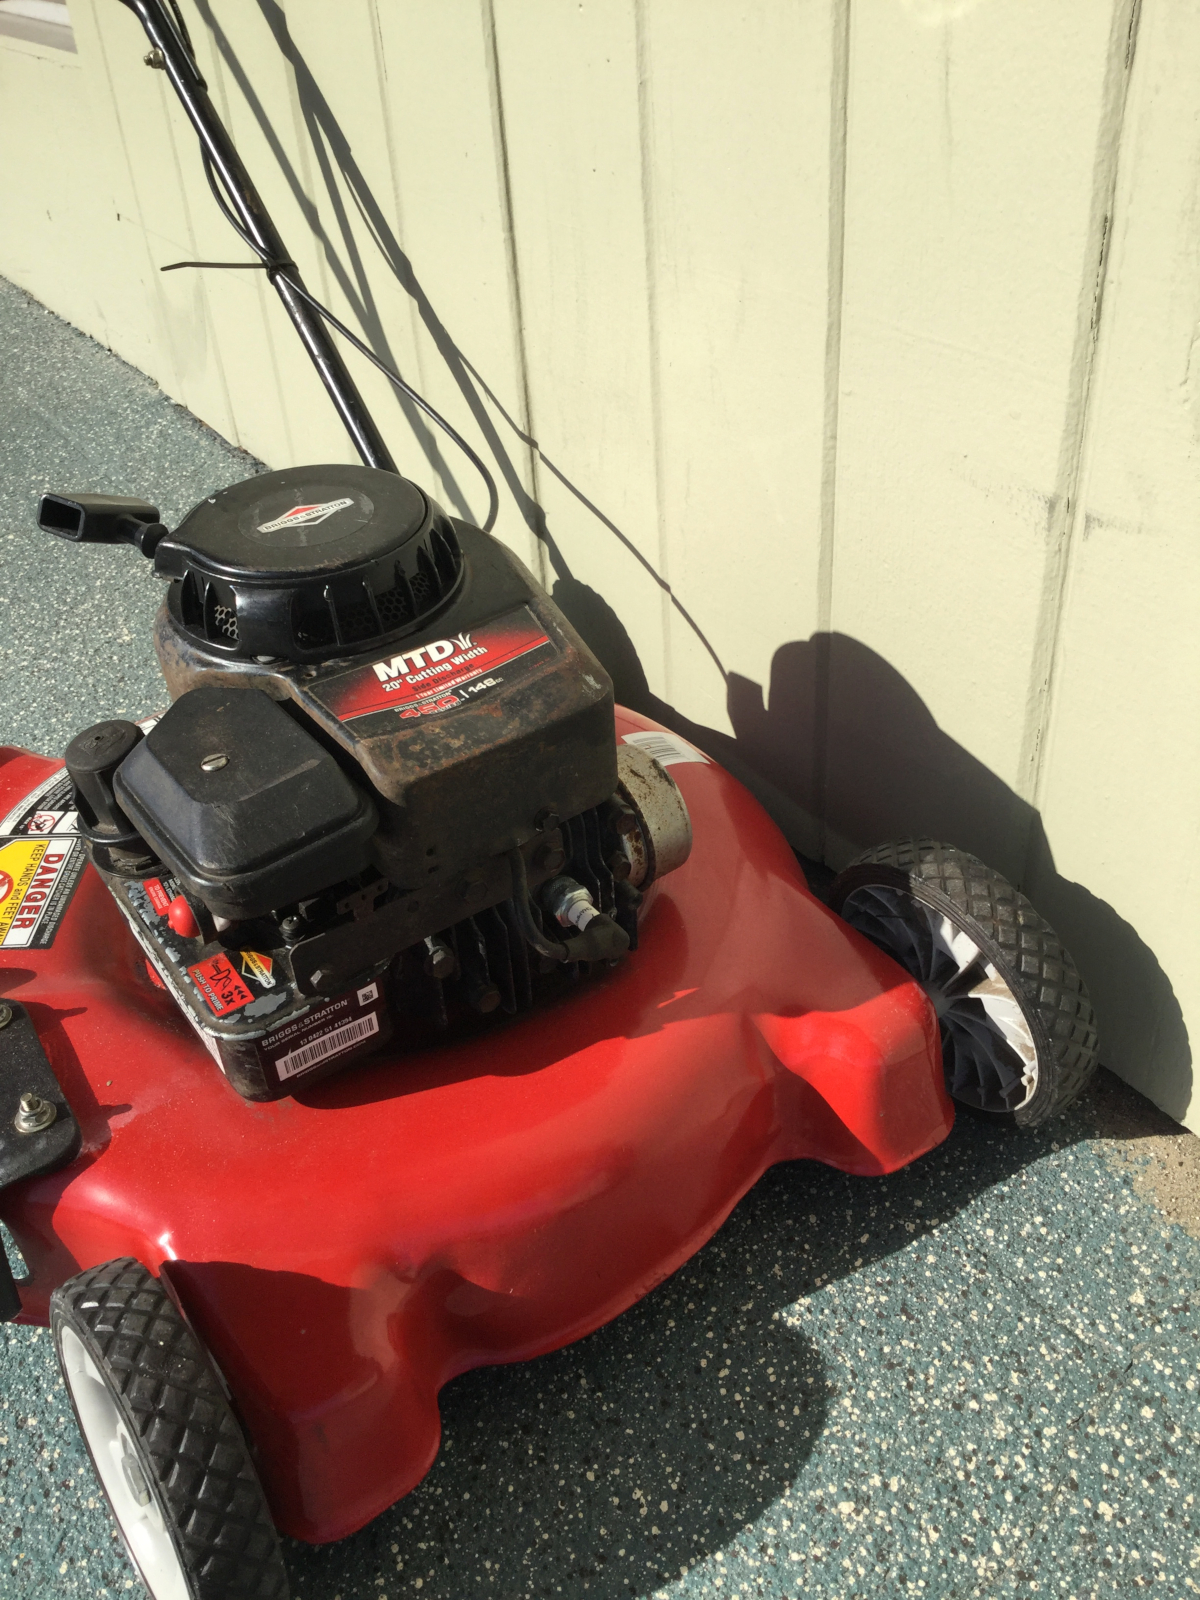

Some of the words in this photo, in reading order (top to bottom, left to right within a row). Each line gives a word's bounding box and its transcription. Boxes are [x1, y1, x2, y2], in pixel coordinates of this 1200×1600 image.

[372, 640, 454, 682] MTD
[405, 663, 453, 684] Cutting
[450, 647, 488, 665] Width
[411, 681, 431, 692] Side
[432, 663, 474, 685] Discharge
[420, 690, 434, 699] Year
[433, 680, 457, 693] Limited
[456, 668, 483, 683] Warranty
[400, 695, 460, 719] 450
[30, 844, 46, 861] KEEP
[17, 863, 37, 887] HANDS
[10, 888, 22, 901] and
[12, 854, 65, 929] DANGER
[2, 902, 19, 920] FEET
[192, 969, 206, 985] PUSH
[203, 983, 212, 993] TO
[208, 992, 223, 1011] PRIME
